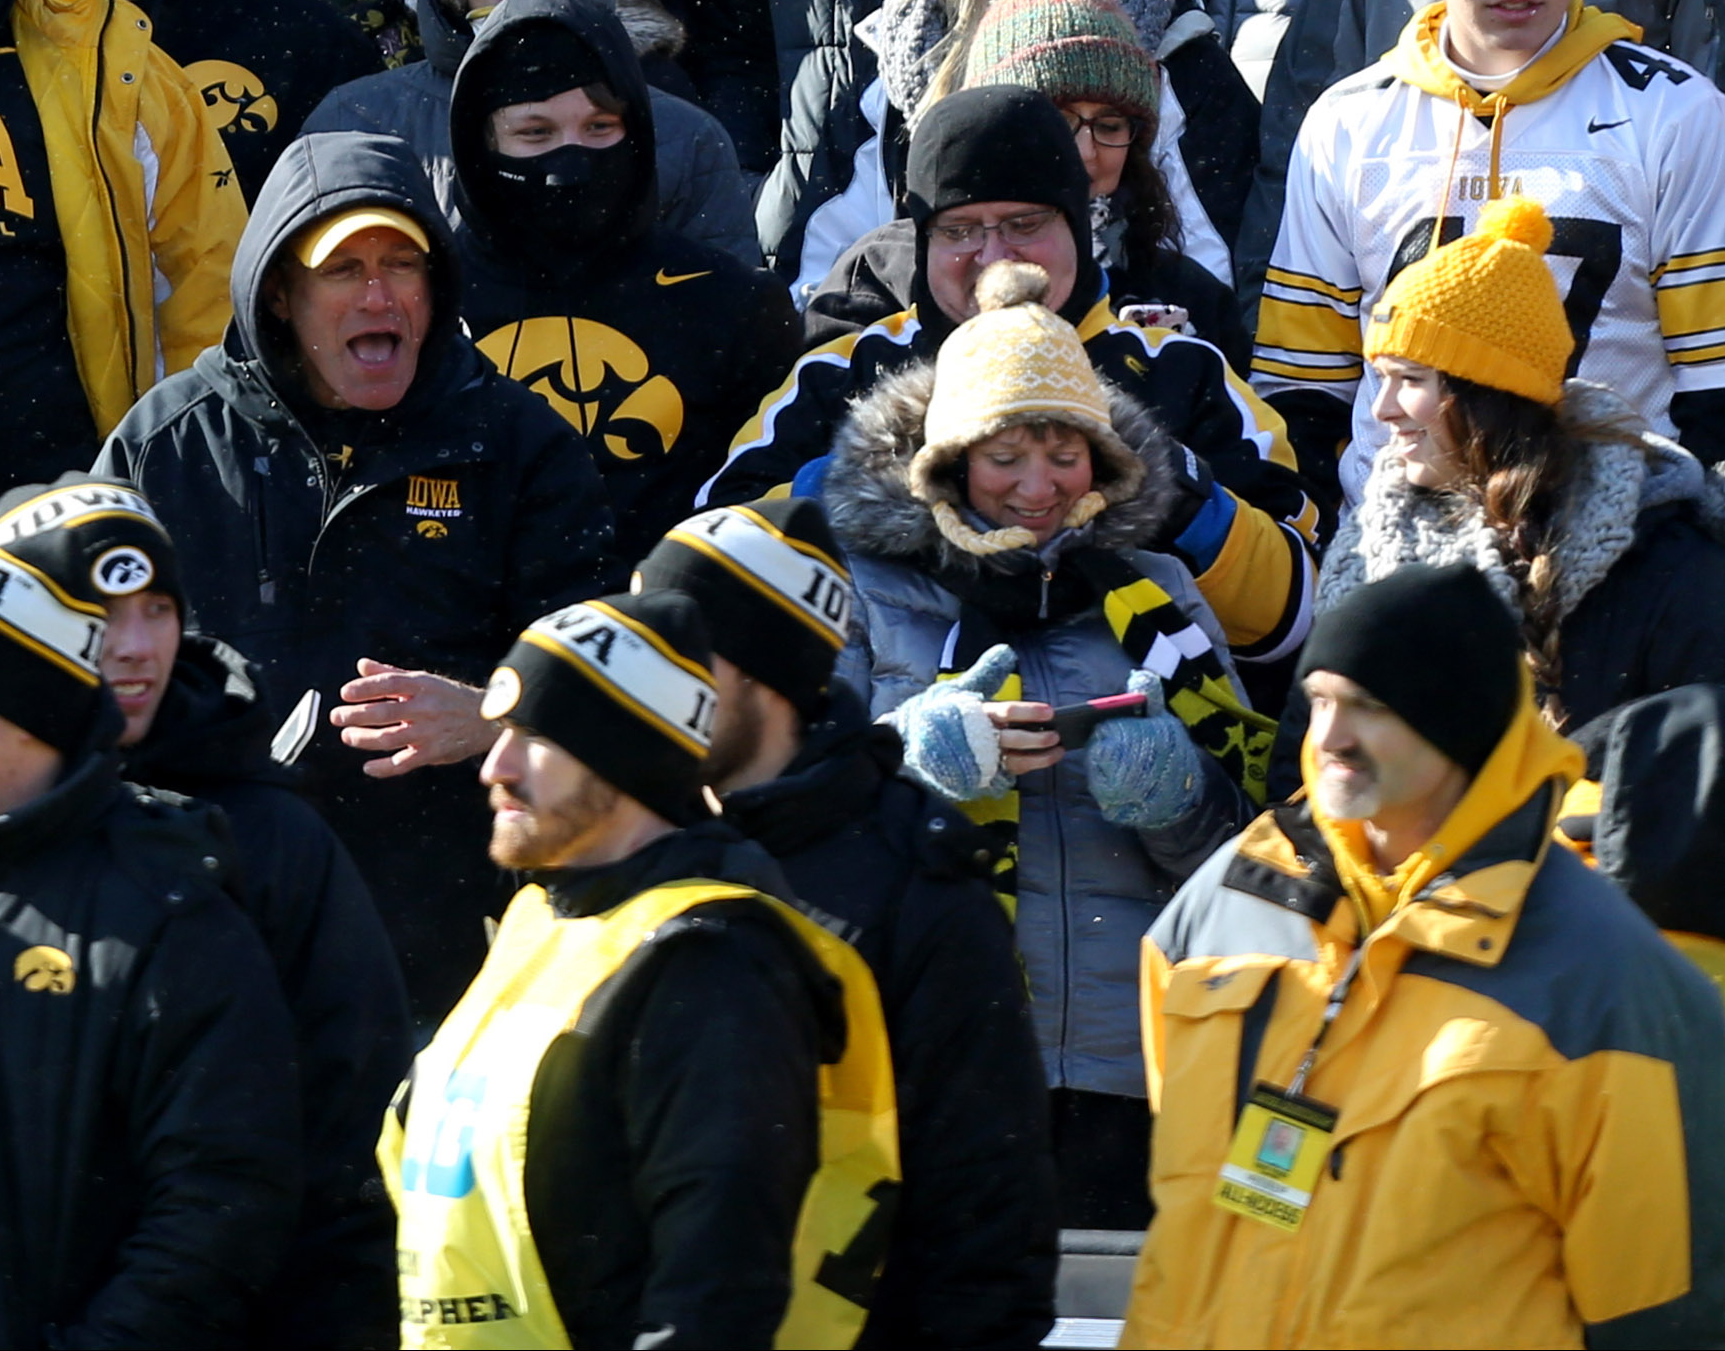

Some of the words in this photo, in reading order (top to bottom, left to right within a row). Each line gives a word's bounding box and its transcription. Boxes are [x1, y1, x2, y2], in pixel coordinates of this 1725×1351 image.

[406, 475, 461, 509] IOWA
[405, 506, 461, 518] HAWKEYES
[800, 566, 849, 624] IO
